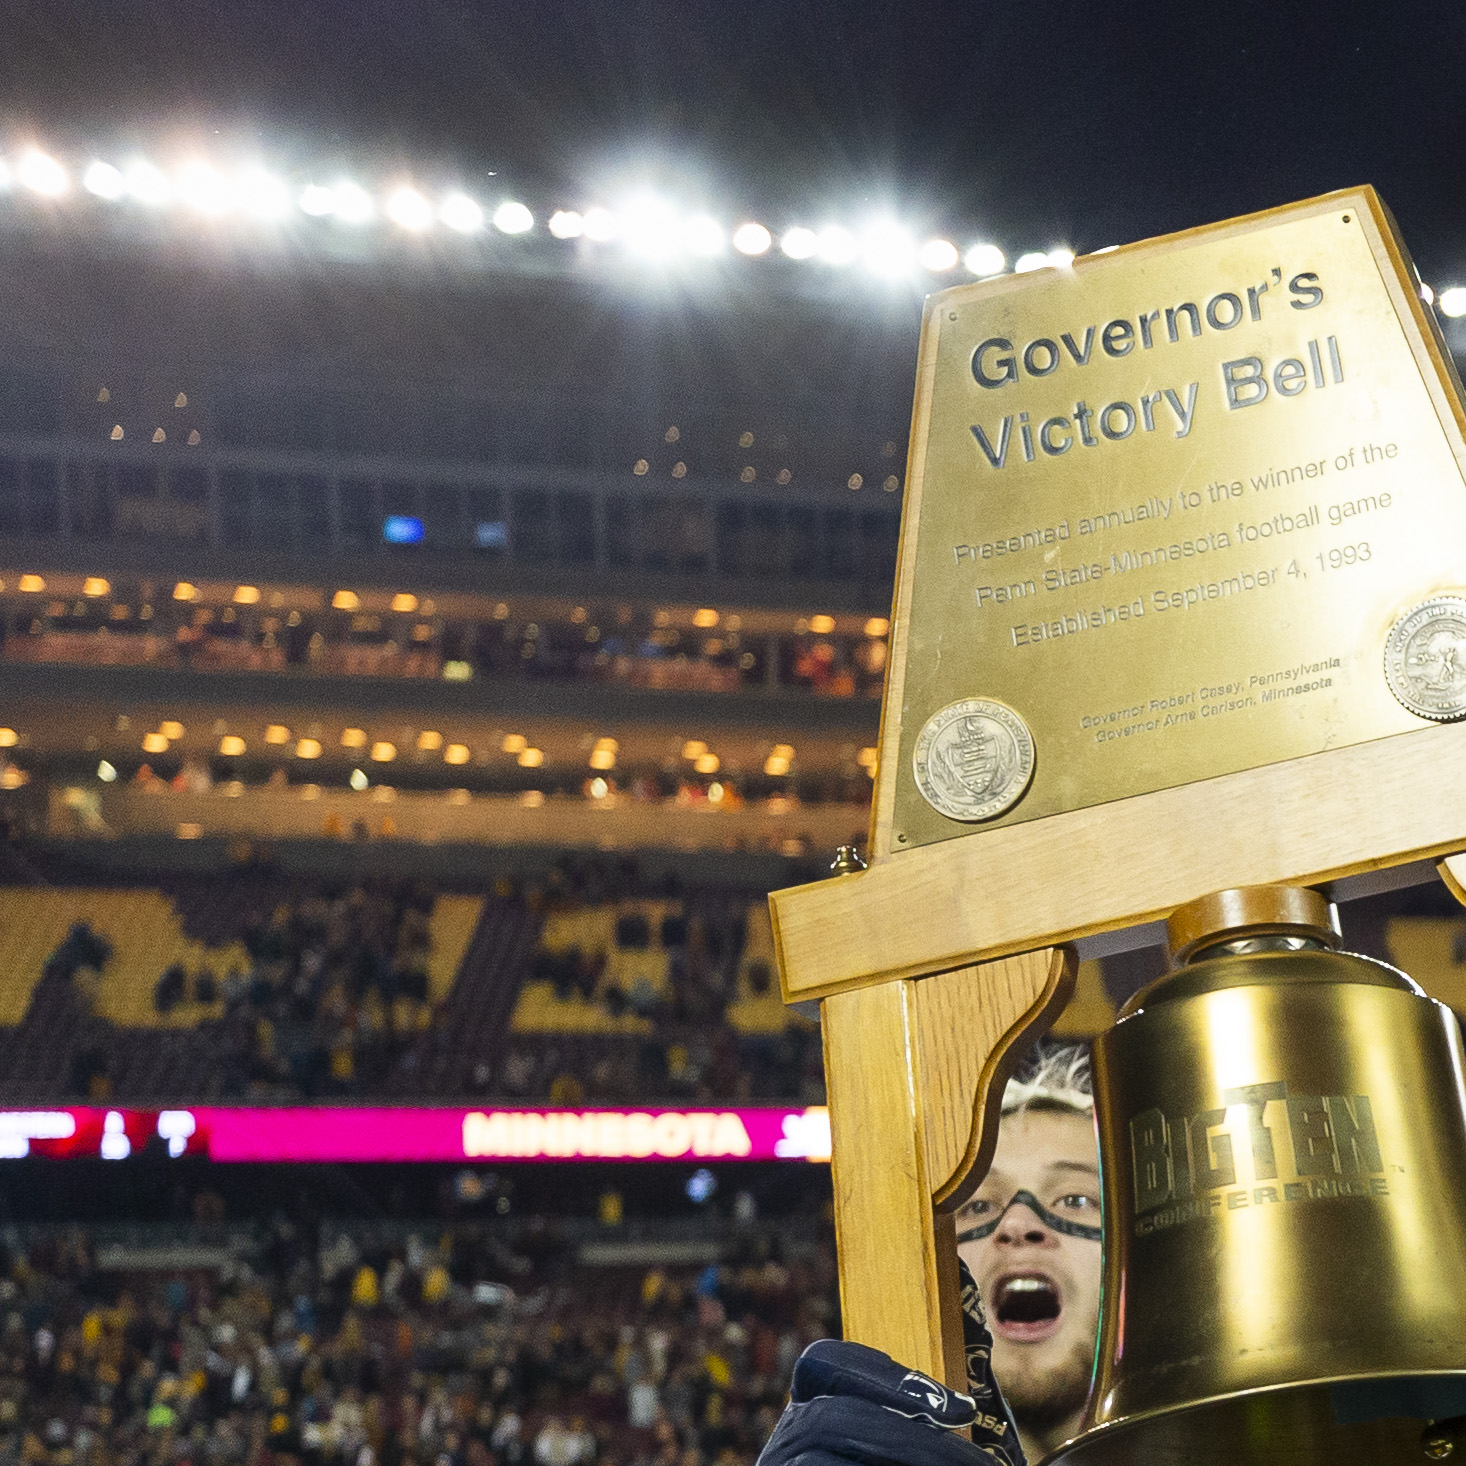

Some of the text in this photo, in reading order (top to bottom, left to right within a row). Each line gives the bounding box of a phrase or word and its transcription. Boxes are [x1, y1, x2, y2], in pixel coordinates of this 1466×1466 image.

[970, 266, 1324, 390] Governor's
[969, 334, 1344, 469] Victory Bell
[953, 442, 1399, 566] Presented annually to the winner of the
[975, 491, 1393, 609] Penn State-Minnesota football game
[1010, 541, 1373, 648] Established September 4, 1993
[1080, 703, 1146, 730] Governor
[1147, 692, 1196, 714] Robert
[1249, 656, 1341, 688] Pennsylvania
[1094, 718, 1162, 744] Governor
[1260, 676, 1333, 704] Minnesota
[462, 1111, 753, 1158] MINNESOTA
